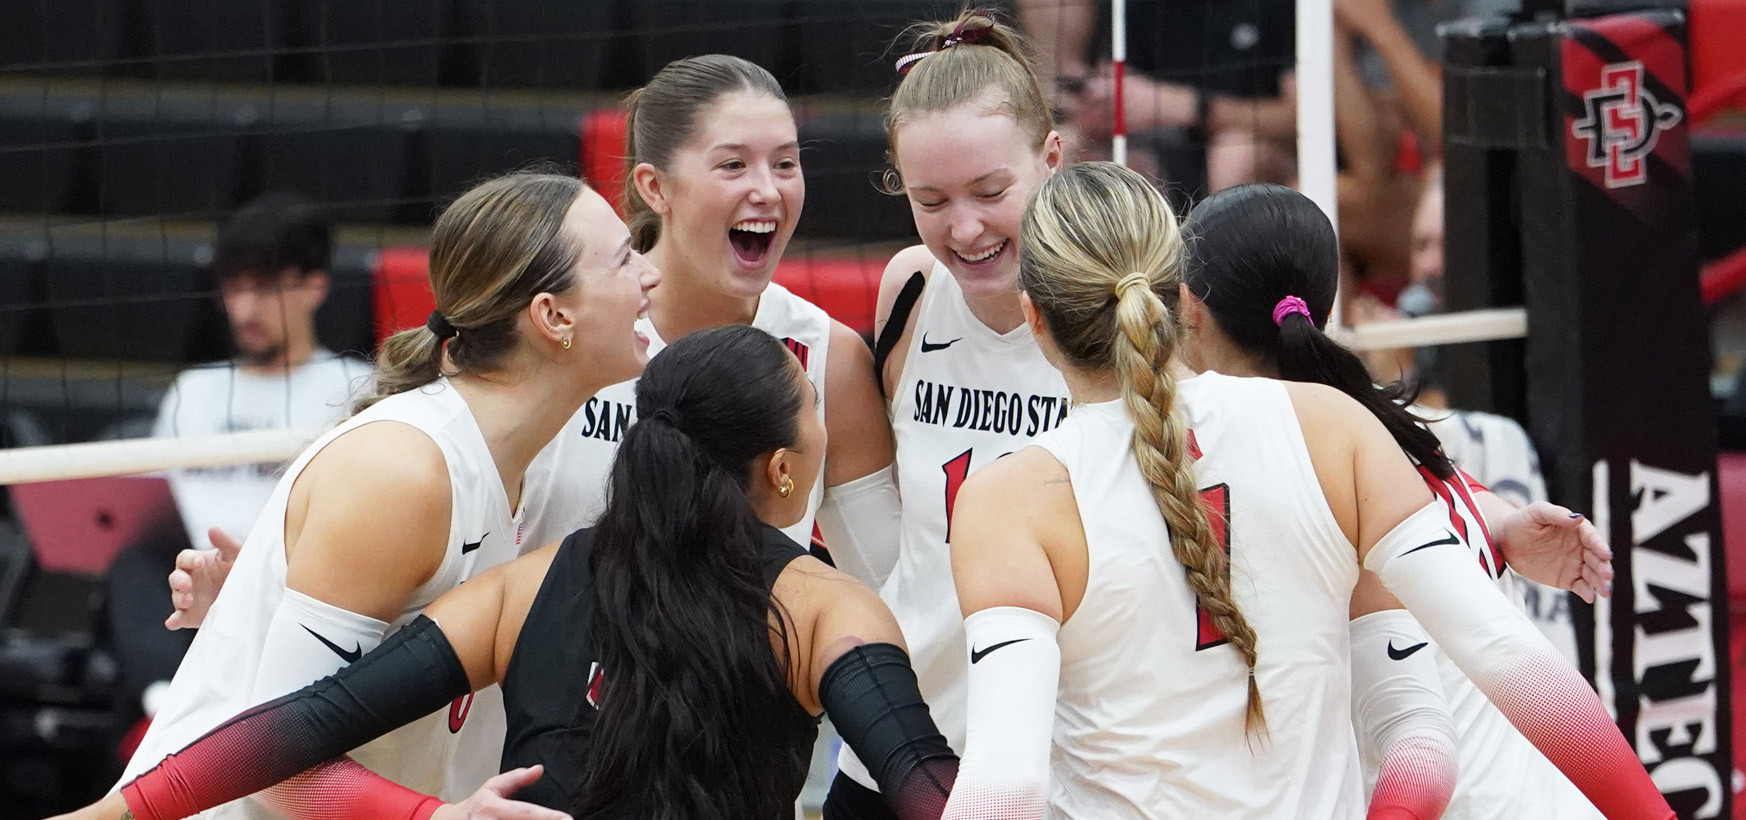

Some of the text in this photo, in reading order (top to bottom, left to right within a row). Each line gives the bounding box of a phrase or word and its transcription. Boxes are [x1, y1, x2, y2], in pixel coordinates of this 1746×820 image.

[581, 396, 632, 442] SAN
[913, 379, 1074, 437] SAN DIEGO STA
[1629, 458, 1724, 820] AZTEC
